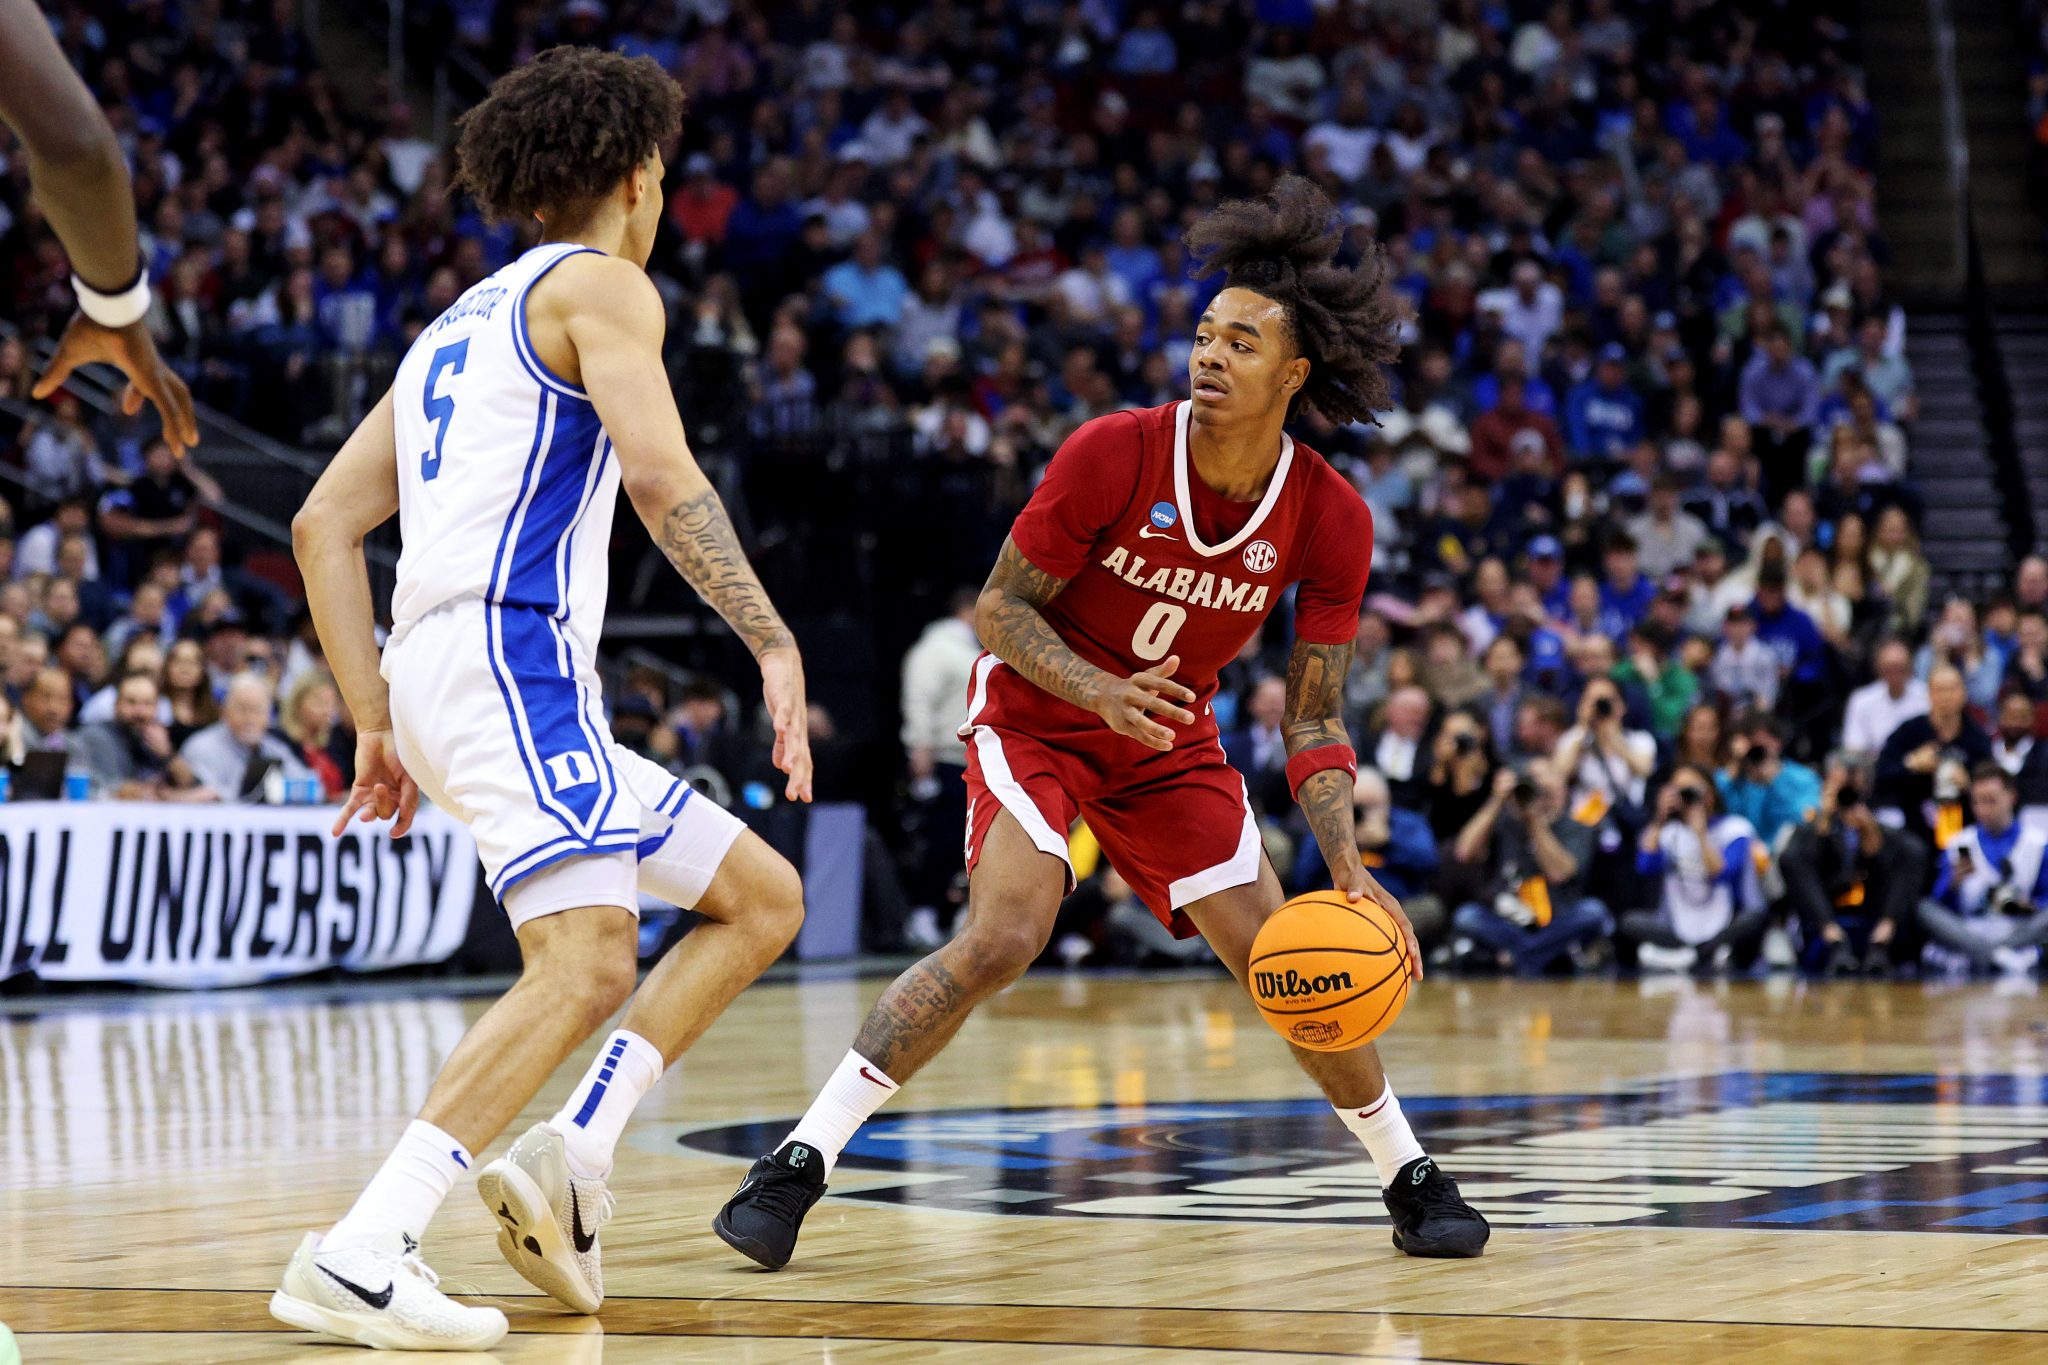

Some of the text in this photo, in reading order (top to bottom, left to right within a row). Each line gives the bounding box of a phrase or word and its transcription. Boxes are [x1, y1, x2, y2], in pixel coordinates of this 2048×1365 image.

[421, 336, 470, 481] 5
[1101, 546, 1270, 613] ALABAMA
[1245, 543, 1275, 571] SEC
[1131, 601, 1187, 661] 0
[544, 750, 599, 793] D
[100, 830, 451, 962] UNIVERSITY
[1255, 969, 1354, 999] Wilson
